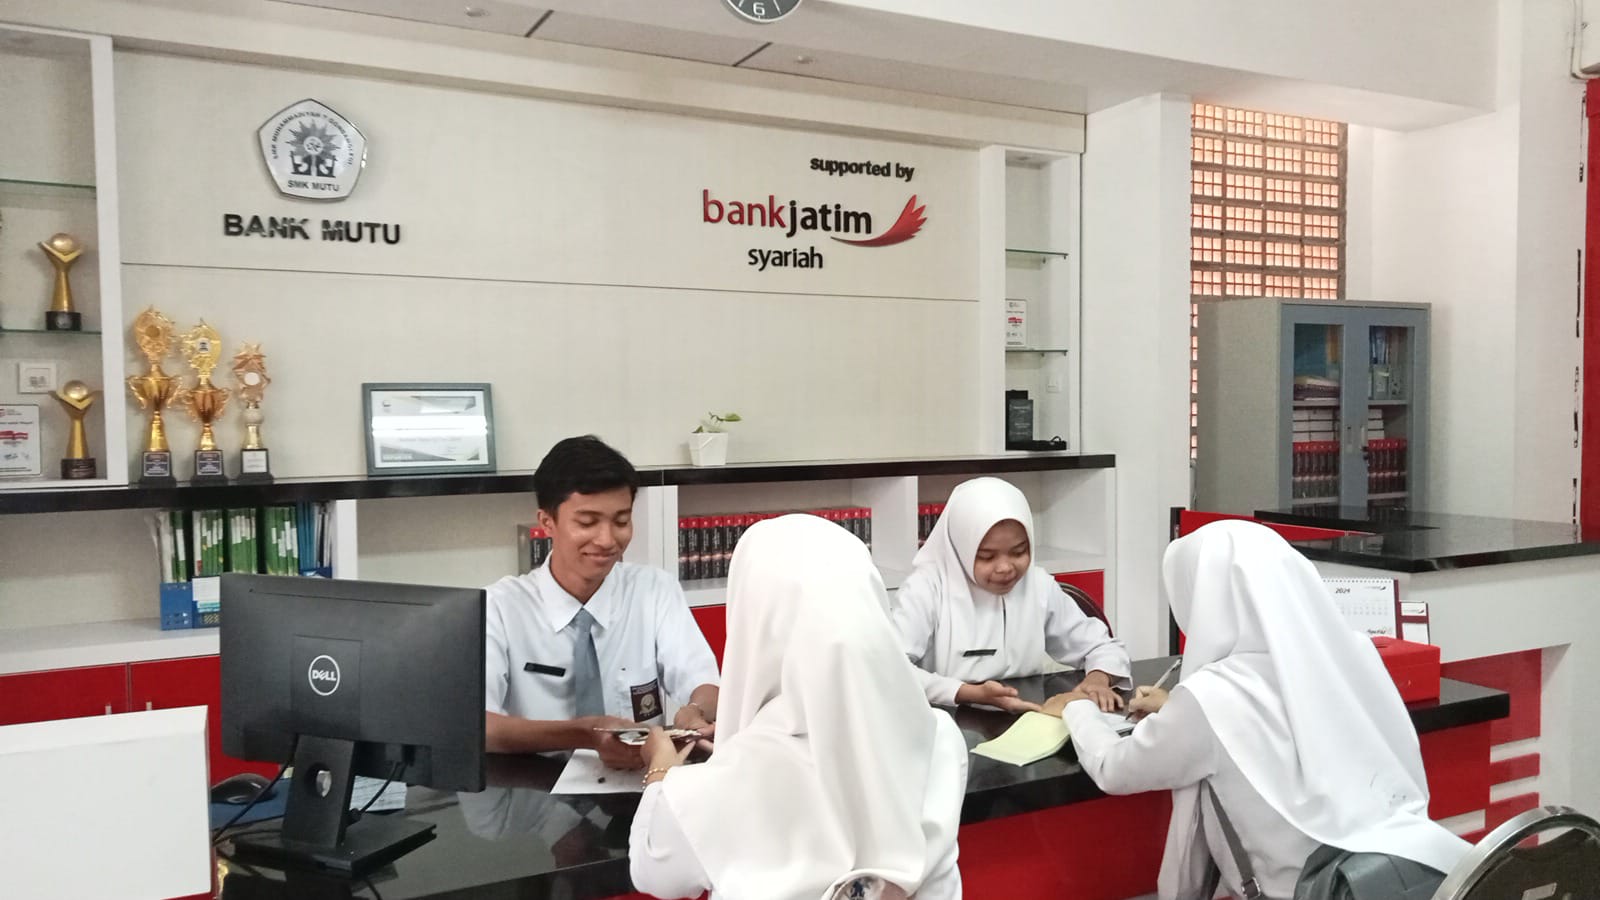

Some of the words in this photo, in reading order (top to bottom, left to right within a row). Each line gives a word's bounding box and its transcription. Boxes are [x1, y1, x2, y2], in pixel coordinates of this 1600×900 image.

[753, 2, 765, 16] 6
[810, 157, 891, 177] supported
[895, 162, 915, 182] by
[287, 179, 310, 190] SMK
[311, 181, 340, 192] MUTU
[223, 213, 310, 240] BANK
[321, 219, 400, 245] MUTU
[748, 246, 824, 272] syariah
[312, 669, 337, 682] DELL
